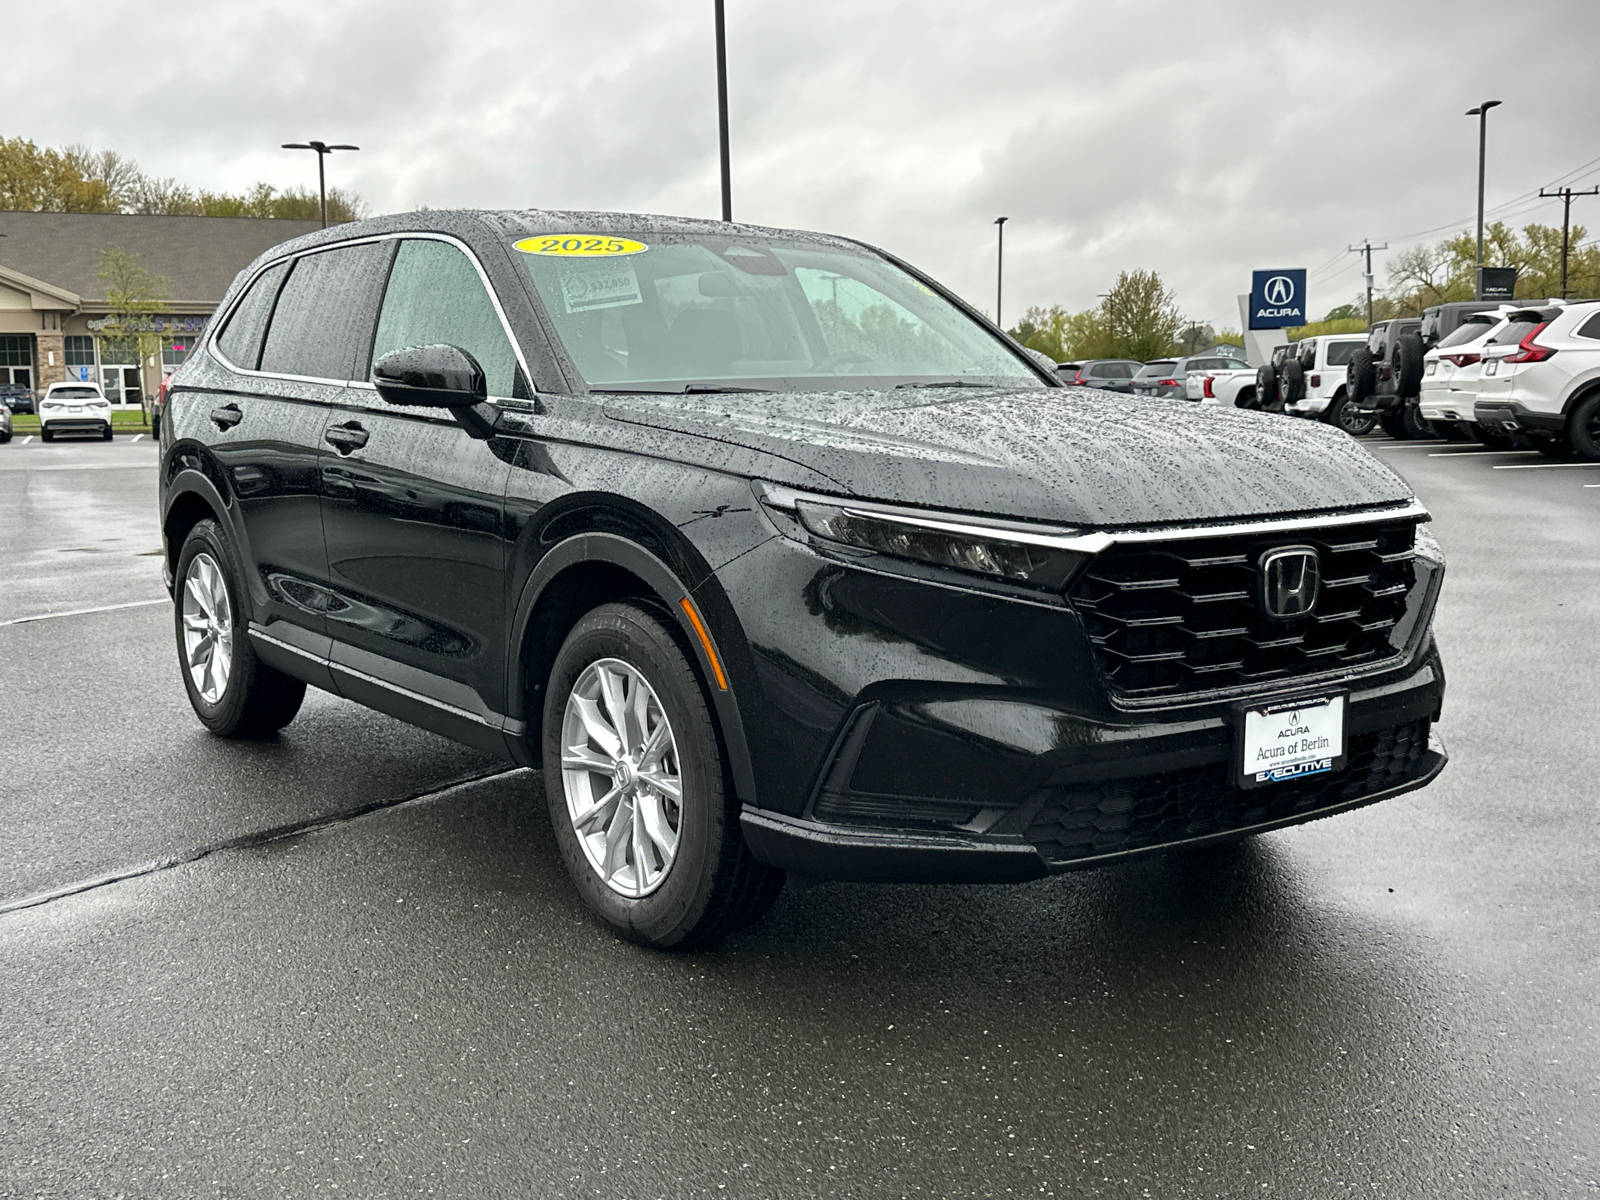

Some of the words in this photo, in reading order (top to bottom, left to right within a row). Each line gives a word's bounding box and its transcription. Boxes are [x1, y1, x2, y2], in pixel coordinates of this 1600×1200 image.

[540, 239, 625, 252] 2025
[1256, 308, 1301, 318] ACURA
[1278, 726, 1310, 738] ACURA
[1257, 747, 1285, 760] Acura
[1287, 742, 1298, 755] of
[1301, 736, 1329, 752] Berlin
[1255, 758, 1332, 782] EXECUTIVE
